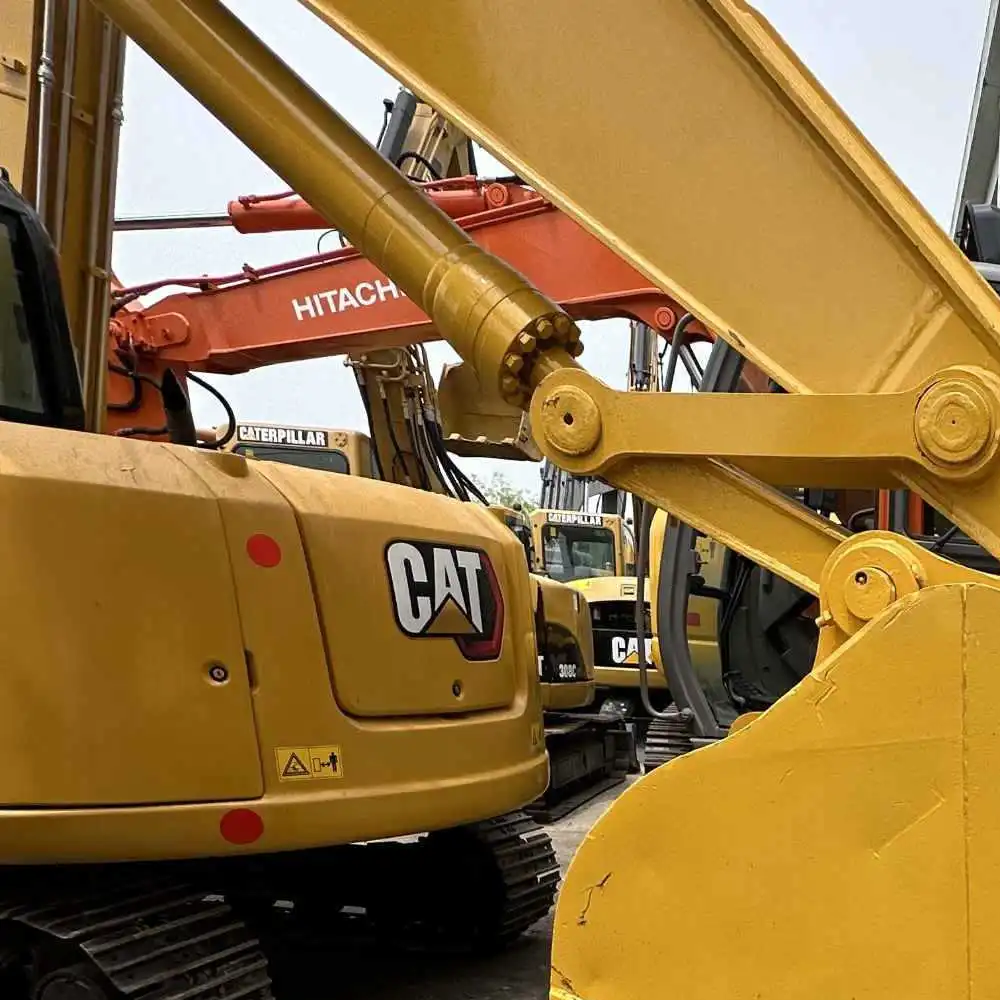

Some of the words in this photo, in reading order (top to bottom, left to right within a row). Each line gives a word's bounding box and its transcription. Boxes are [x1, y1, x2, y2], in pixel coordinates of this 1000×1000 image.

[292, 278, 406, 320] HITACH
[239, 426, 325, 446] CATERPILLAR
[387, 542, 483, 633] CAT
